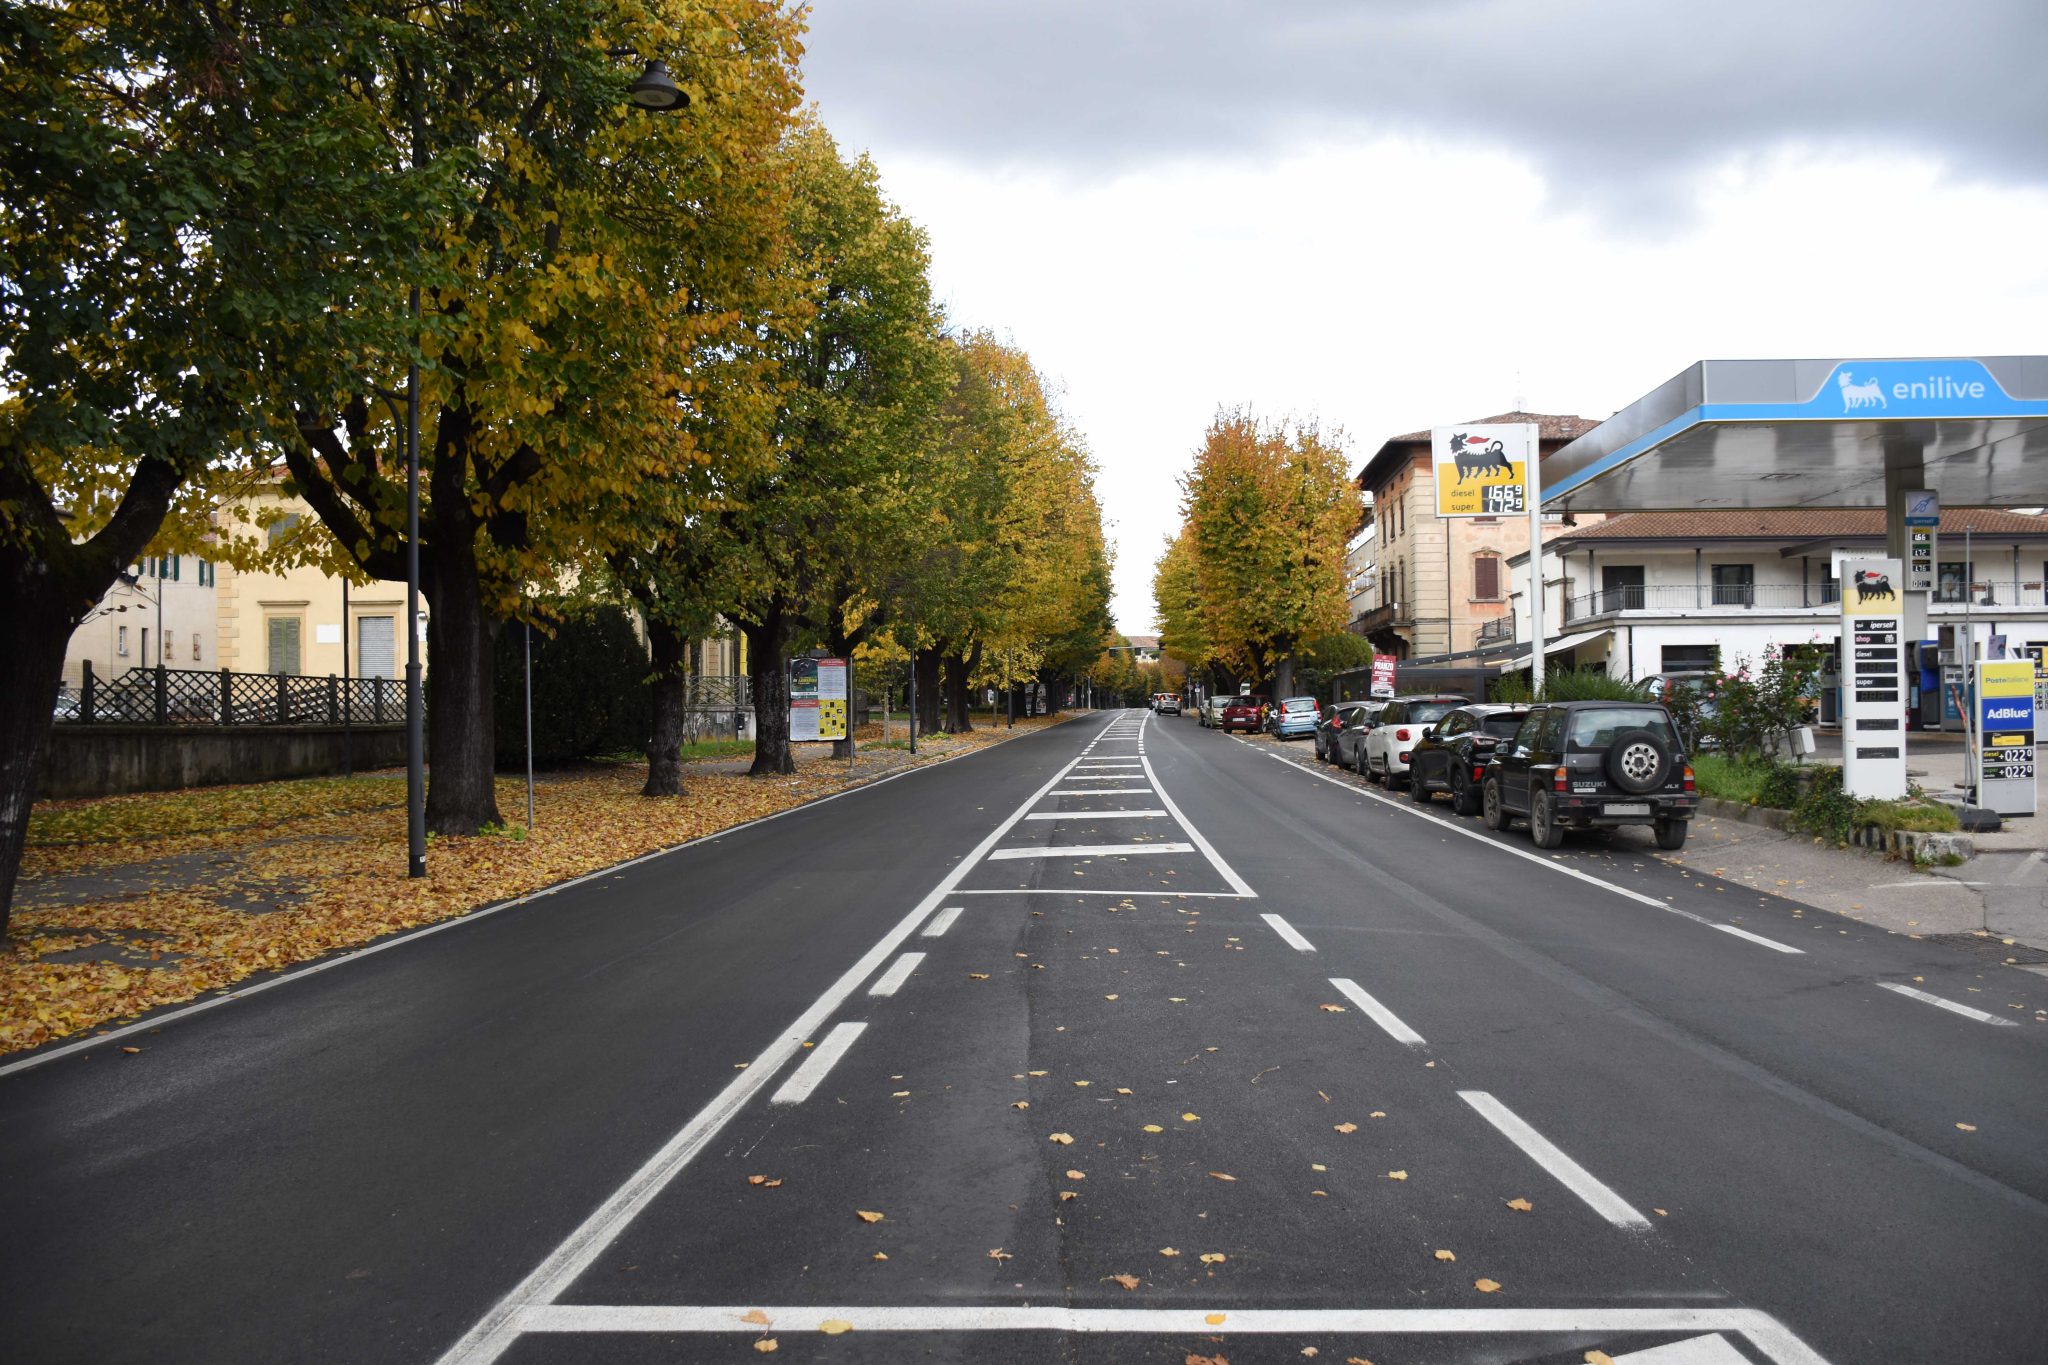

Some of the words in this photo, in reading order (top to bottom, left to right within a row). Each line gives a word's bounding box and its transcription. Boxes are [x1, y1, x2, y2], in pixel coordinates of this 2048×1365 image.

[1892, 376, 1985, 399] enilive
[1451, 489, 1475, 497] diesel
[1451, 504, 1475, 512] super
[1870, 621, 1895, 630] iperself
[1855, 635, 1871, 643] shop
